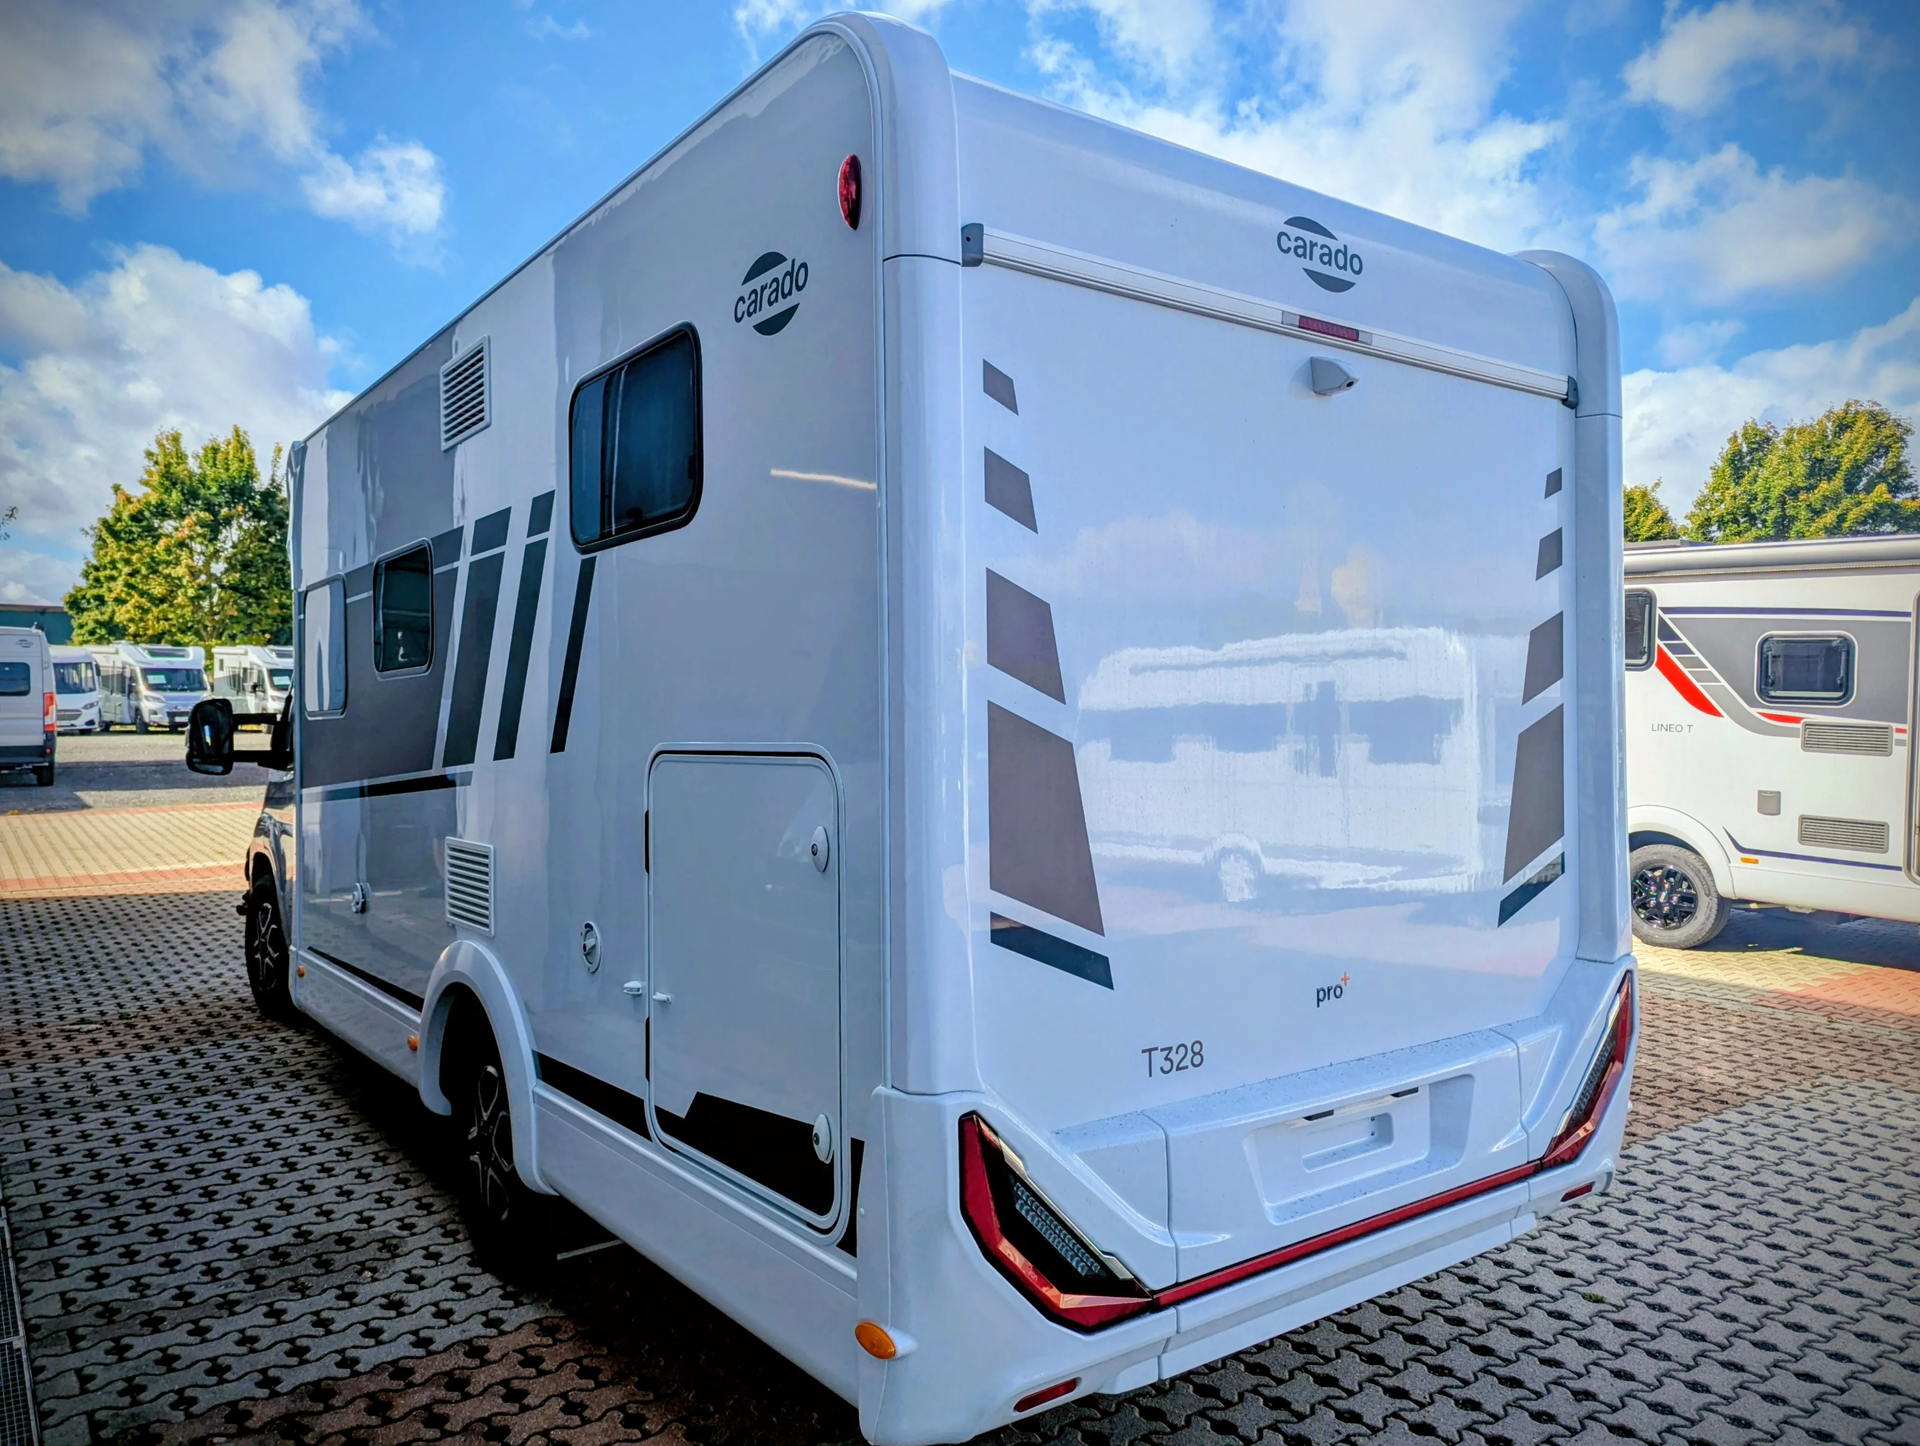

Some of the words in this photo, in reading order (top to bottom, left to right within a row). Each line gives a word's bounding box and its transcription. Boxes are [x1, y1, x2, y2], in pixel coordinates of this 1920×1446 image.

[1276, 230, 1364, 276] carado
[733, 257, 809, 324] carado
[1651, 723, 1684, 733] LINEO
[1686, 724, 1694, 733] T
[1141, 1040, 1204, 1078] T328
